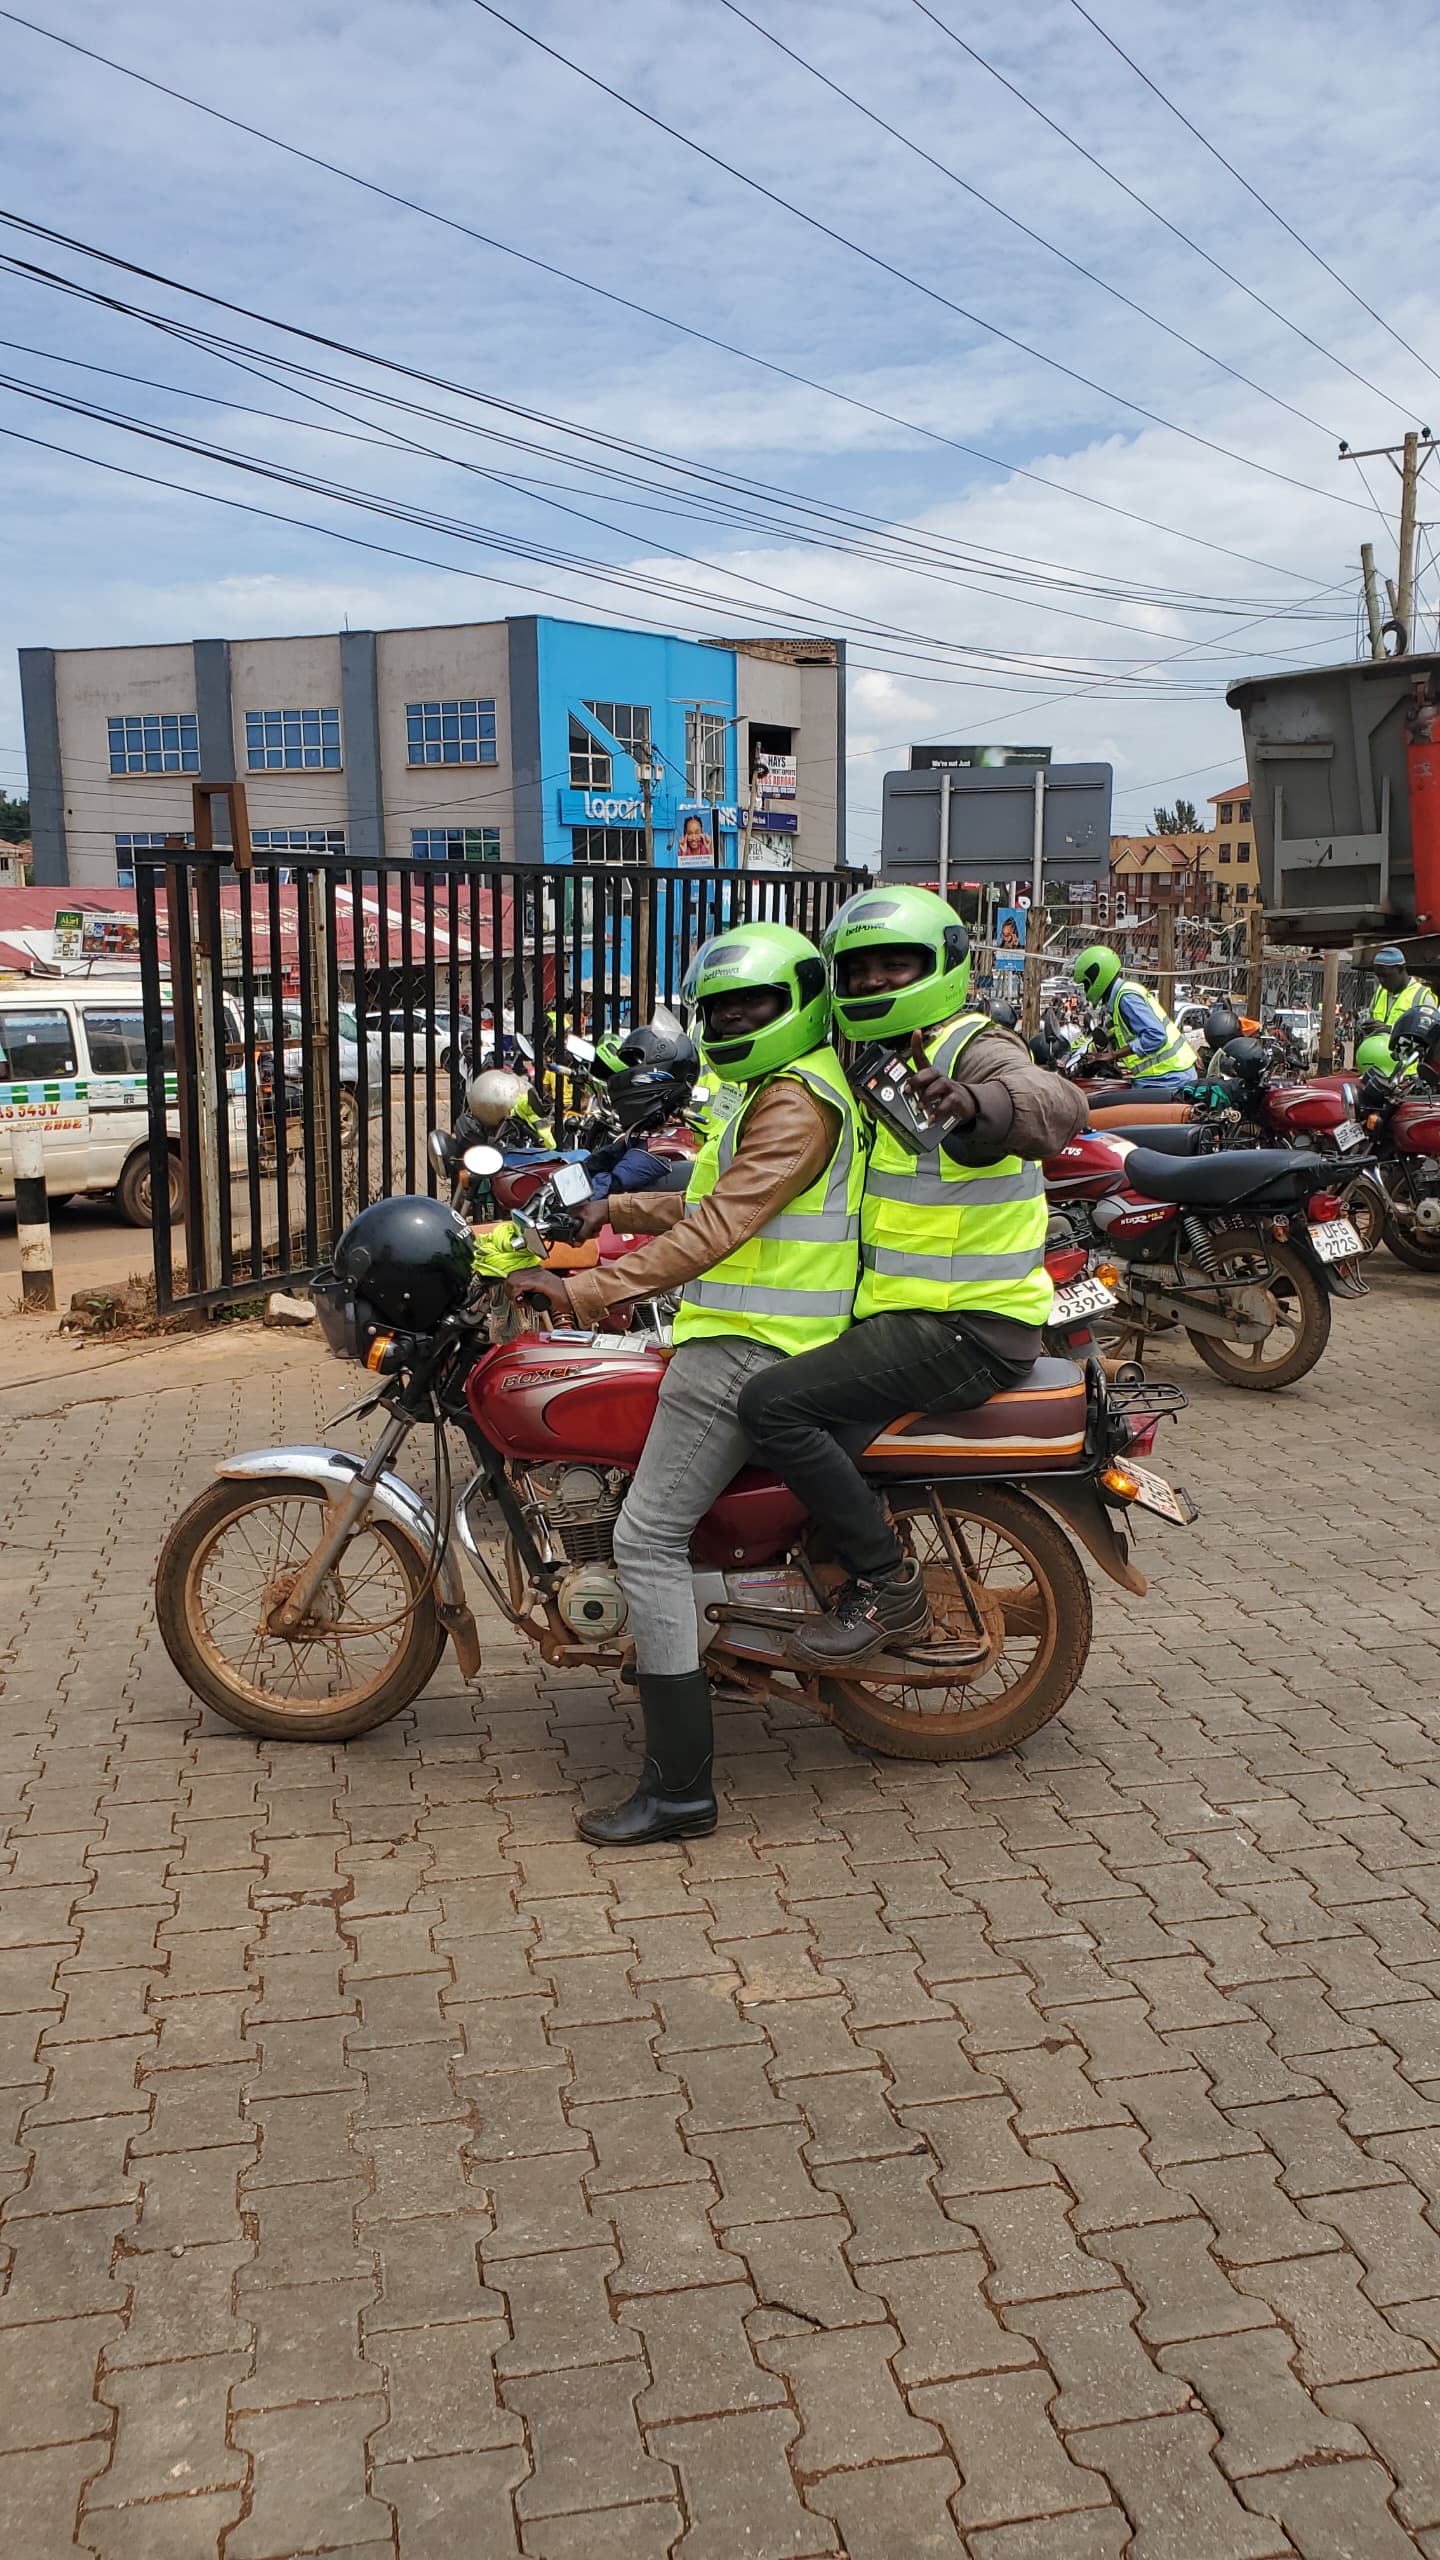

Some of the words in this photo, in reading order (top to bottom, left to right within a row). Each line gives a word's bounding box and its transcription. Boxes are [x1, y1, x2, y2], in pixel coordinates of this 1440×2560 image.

[767, 755, 786, 767] HAYS
[18, 1103, 59, 1118] 543V
[1322, 1222, 1349, 1239] UFG
[1325, 1237, 1358, 1256] 272S
[1057, 1280, 1098, 1301] UFW
[1058, 1292, 1110, 1317] 939C
[500, 1364, 582, 1389] BOXER
